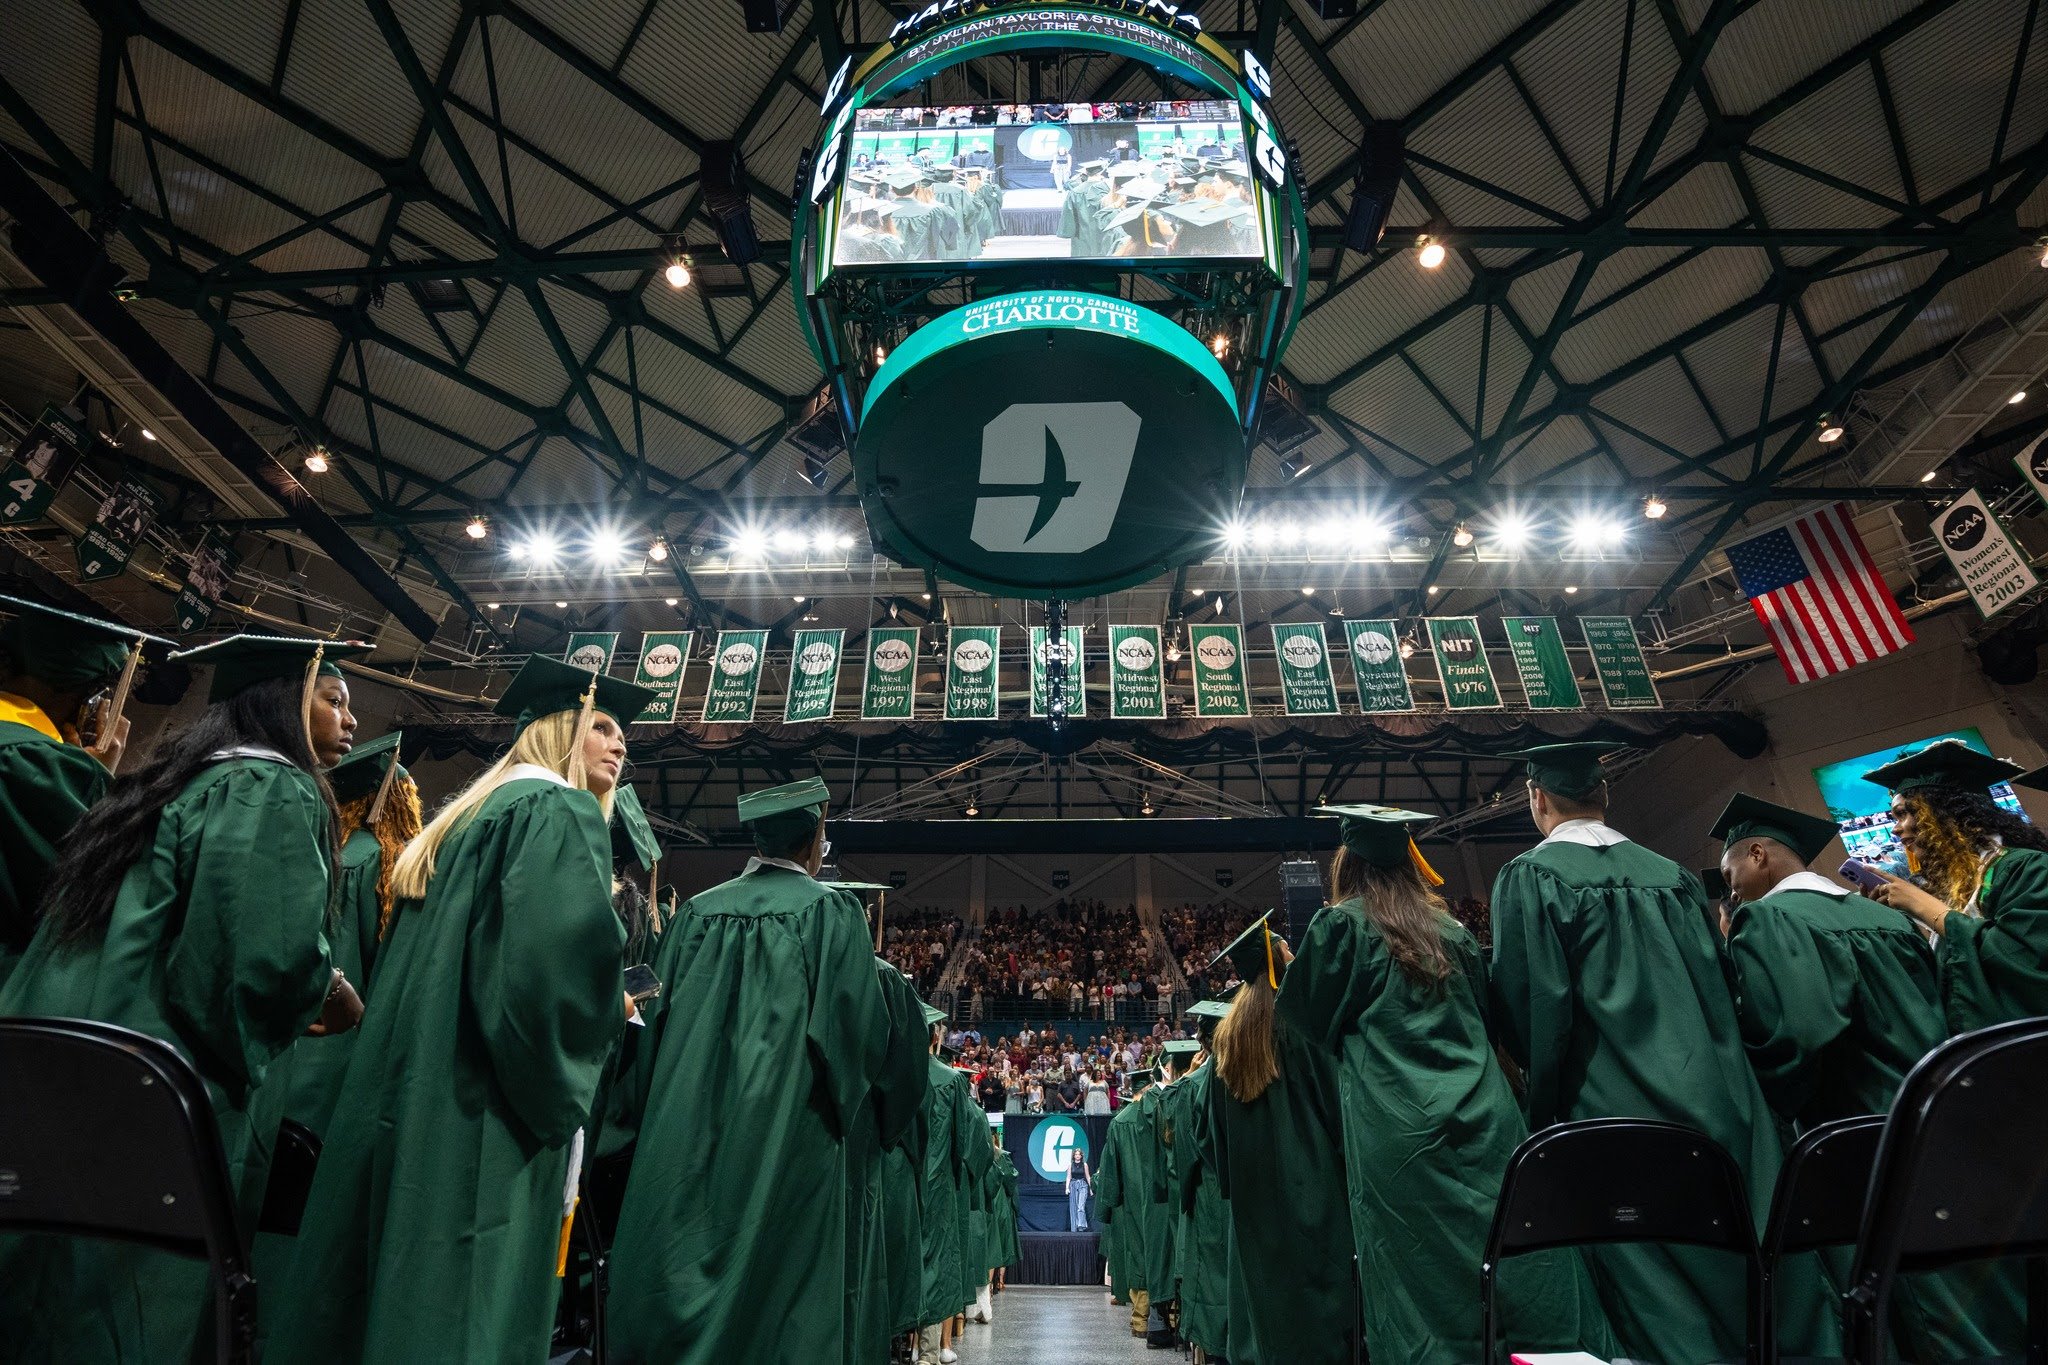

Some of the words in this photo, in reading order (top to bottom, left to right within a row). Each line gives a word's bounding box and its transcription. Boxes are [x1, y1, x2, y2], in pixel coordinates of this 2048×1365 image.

[965, 297, 1026, 316] UNIVERSITY
[1031, 295, 1044, 304] OF
[1049, 296, 1083, 305] NORTH
[1087, 298, 1138, 316] CAROLINA
[962, 303, 1140, 334] CHARLOTTE
[8, 478, 37, 502] 4
[126, 482, 155, 507] MULLINS
[1944, 512, 1984, 544] NCAA
[1959, 537, 2005, 571] Women's
[1966, 547, 2011, 584] Midwest
[1972, 558, 2020, 595] Regional
[1985, 573, 2026, 609] 2003
[1284, 646, 1320, 656] NCAA
[1357, 643, 1391, 652] NCAA
[1441, 639, 1473, 653] NIT
[722, 653, 754, 664] NCAA
[801, 652, 832, 664] NCAA
[876, 650, 910, 660] NCAA
[956, 650, 991, 660] NCAA
[1119, 648, 1153, 658] NCAA
[1200, 648, 1235, 658] NCAA
[571, 656, 602, 665] NCAA
[647, 655, 678, 665] NCAA
[1297, 670, 1315, 678] East
[1447, 664, 1485, 675] Finals
[880, 675, 902, 683] West
[962, 675, 983, 684] East
[1117, 673, 1159, 682] Midwest
[1206, 673, 1233, 681] South
[1359, 671, 1401, 680] Syracuse
[637, 680, 678, 688] Southeast
[724, 679, 744, 687] East
[805, 678, 824, 686] East
[1201, 682, 1241, 693] Regional
[1286, 678, 1330, 687] Rutherford
[795, 685, 831, 698] Regional
[869, 684, 910, 693] Regional
[952, 685, 992, 695] Regional
[1118, 683, 1157, 694] Regional
[1292, 687, 1327, 696] Regional
[1453, 682, 1487, 694] 1976
[713, 689, 751, 699] Regional
[714, 701, 746, 713] 1992
[796, 699, 826, 713] 1995
[871, 696, 905, 708] 1997
[955, 698, 988, 710] 1998
[1121, 696, 1155, 709] 2001
[1206, 695, 1240, 708] 2002
[1295, 698, 1330, 710] 2004
[1369, 695, 1405, 708] 2005
